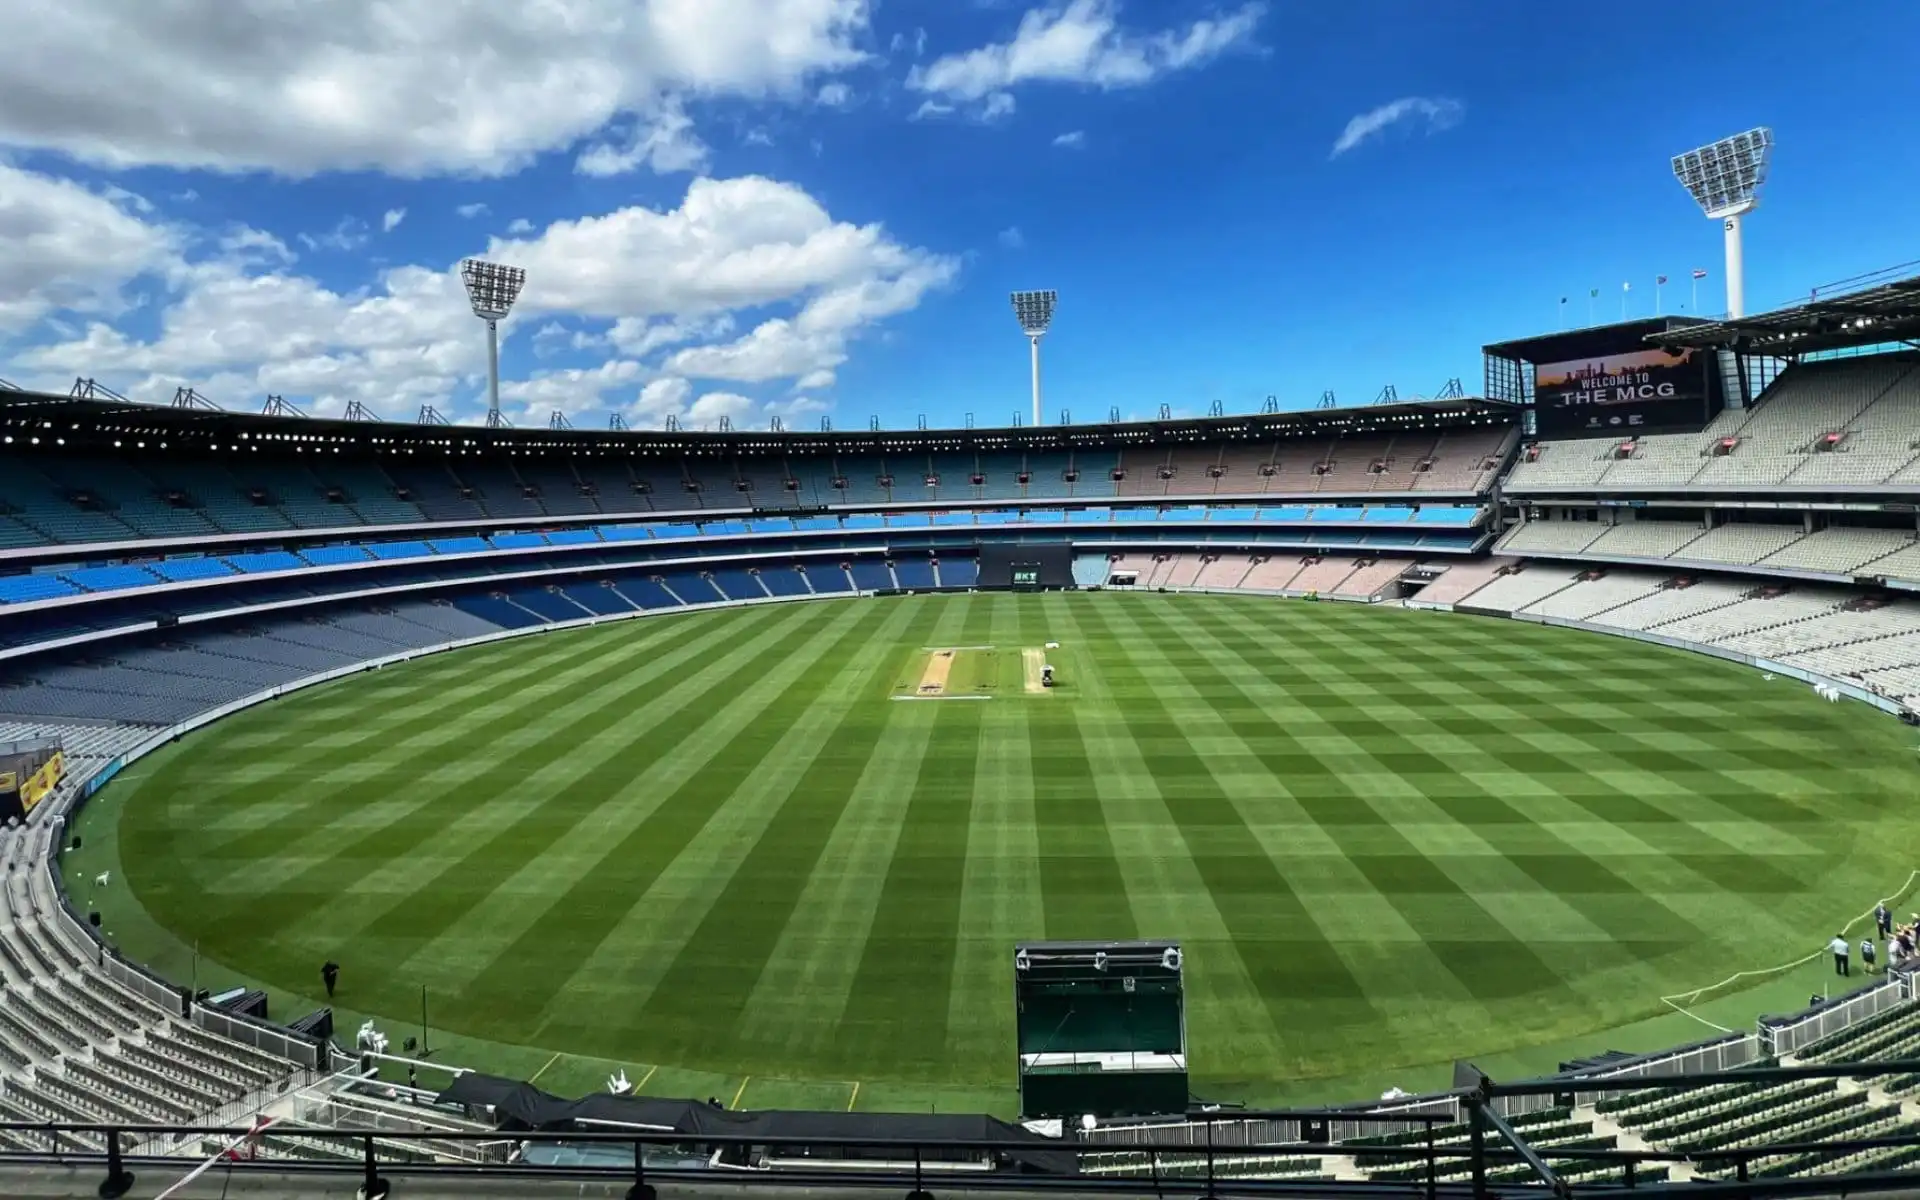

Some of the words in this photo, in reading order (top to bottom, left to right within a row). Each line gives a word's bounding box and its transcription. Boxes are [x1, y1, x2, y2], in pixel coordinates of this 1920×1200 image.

[1726, 220, 1734, 231] 5
[1581, 374, 1632, 389] WELCOME
[1635, 372, 1649, 383] TO
[1561, 389, 1607, 405] THE
[1616, 382, 1675, 401] MCG
